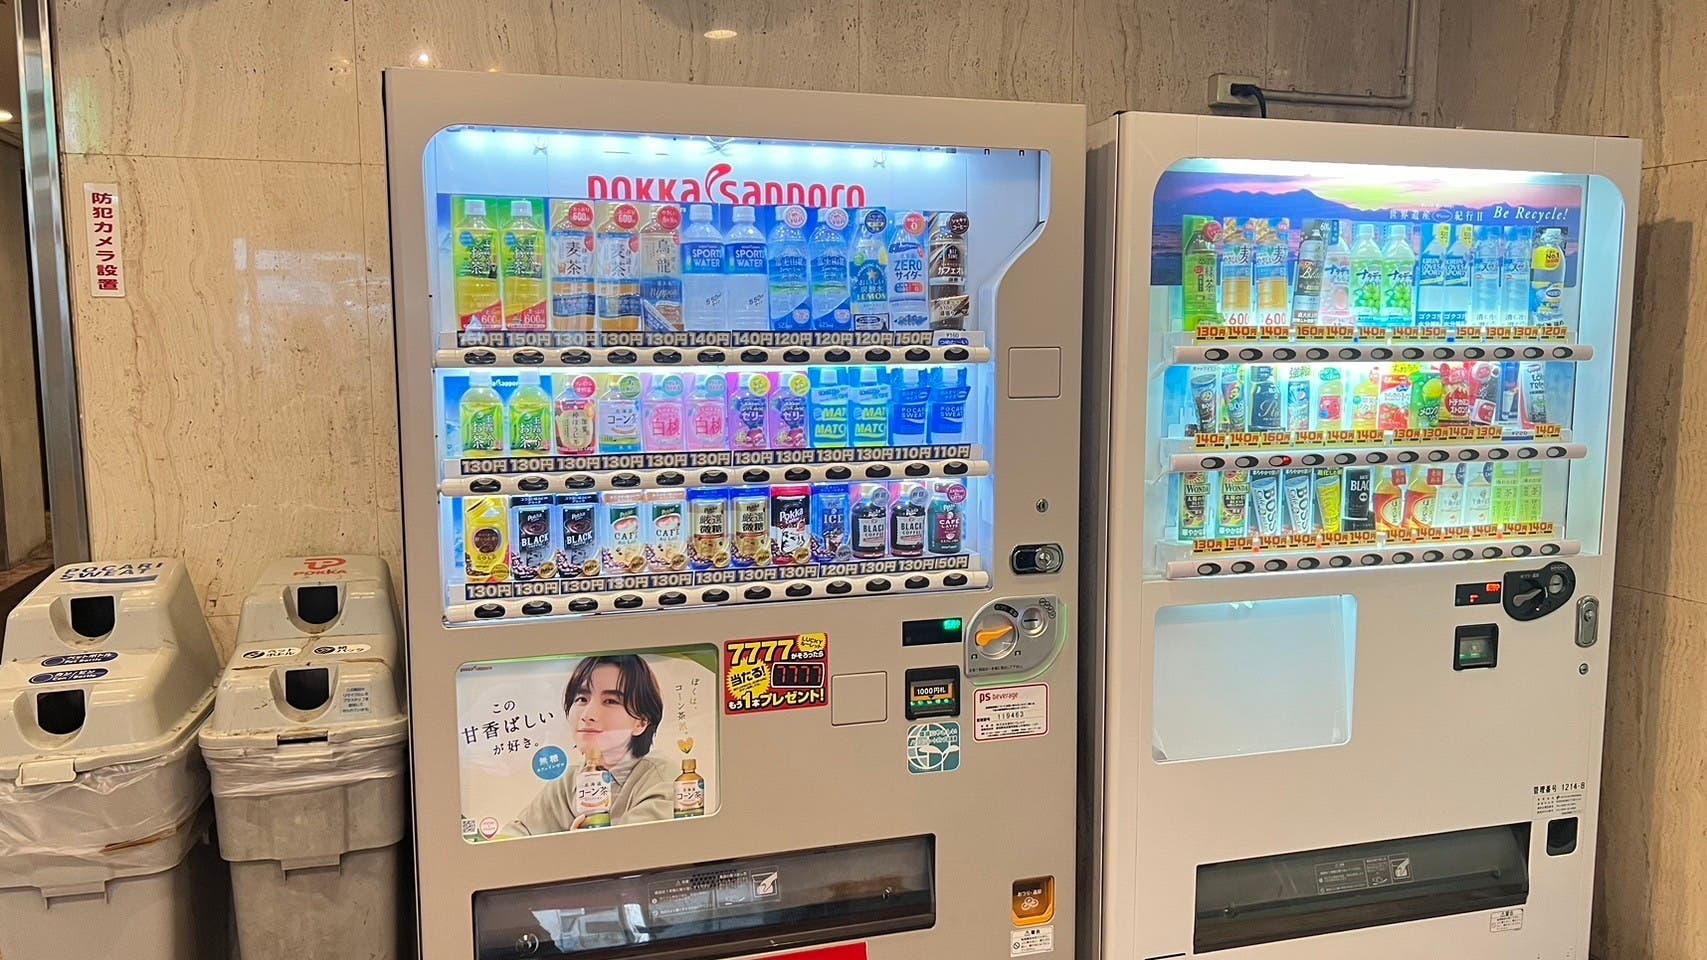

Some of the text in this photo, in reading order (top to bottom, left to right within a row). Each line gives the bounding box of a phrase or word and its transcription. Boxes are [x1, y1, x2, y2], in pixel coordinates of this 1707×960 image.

[1493, 206, 1569, 224] Be Recycle!
[91, 192, 119, 291] 防犯カメラ設置
[567, 241, 581, 275] 麦茶
[693, 258, 720, 268] WATER
[736, 258, 764, 268] WATER
[894, 259, 922, 271] ZERO
[895, 271, 922, 281] サイダー
[507, 332, 551, 346] 150円
[554, 332, 595, 346] 130円
[601, 332, 643, 346] 130円
[645, 332, 688, 346] 130円
[689, 332, 730, 346] 140円
[734, 332, 773, 346] 140円
[775, 332, 813, 346] 120円
[815, 332, 851, 345] 120円
[855, 332, 892, 344] 120円
[896, 332, 932, 344] 150円
[741, 410, 765, 421] ゼリー
[783, 410, 805, 421] ゼリー
[735, 452, 773, 464] 130円
[776, 451, 814, 463] 130円
[817, 449, 854, 462] 130円
[858, 449, 893, 460] 130円
[895, 448, 931, 459] 110円
[935, 446, 969, 458] 110円
[462, 459, 507, 473] 130円
[511, 458, 555, 472] 130円
[558, 457, 600, 471] 130円
[602, 455, 644, 469] 130円
[647, 454, 687, 468] 130円
[691, 453, 730, 466] 130円
[780, 508, 804, 521] Pokka
[823, 513, 844, 524] ICE
[521, 533, 549, 547] BLACK
[566, 531, 592, 545] BLACK
[65, 562, 163, 574] POCARI
[821, 562, 858, 576] 120円
[860, 560, 896, 574] 130円
[900, 558, 934, 572] 130円
[935, 556, 968, 570] 150円
[60, 569, 146, 580] SWEAT
[697, 570, 735, 584] 130円
[739, 567, 777, 581] 130円
[780, 565, 818, 579] 130円
[562, 579, 605, 593] 130円
[608, 576, 648, 591] 130円
[652, 573, 692, 587] 130円
[467, 584, 512, 599] 130円
[515, 582, 559, 596] 130円
[728, 639, 794, 665] 7777
[791, 650, 824, 660] がそろったら
[730, 665, 766, 687] 当たる!
[777, 665, 820, 683] 7777
[993, 691, 1018, 700] beverage
[492, 700, 516, 714] この
[461, 711, 554, 745] 甘香ばしい
[493, 737, 539, 755] が好き。
[579, 786, 608, 799] コーン茶
